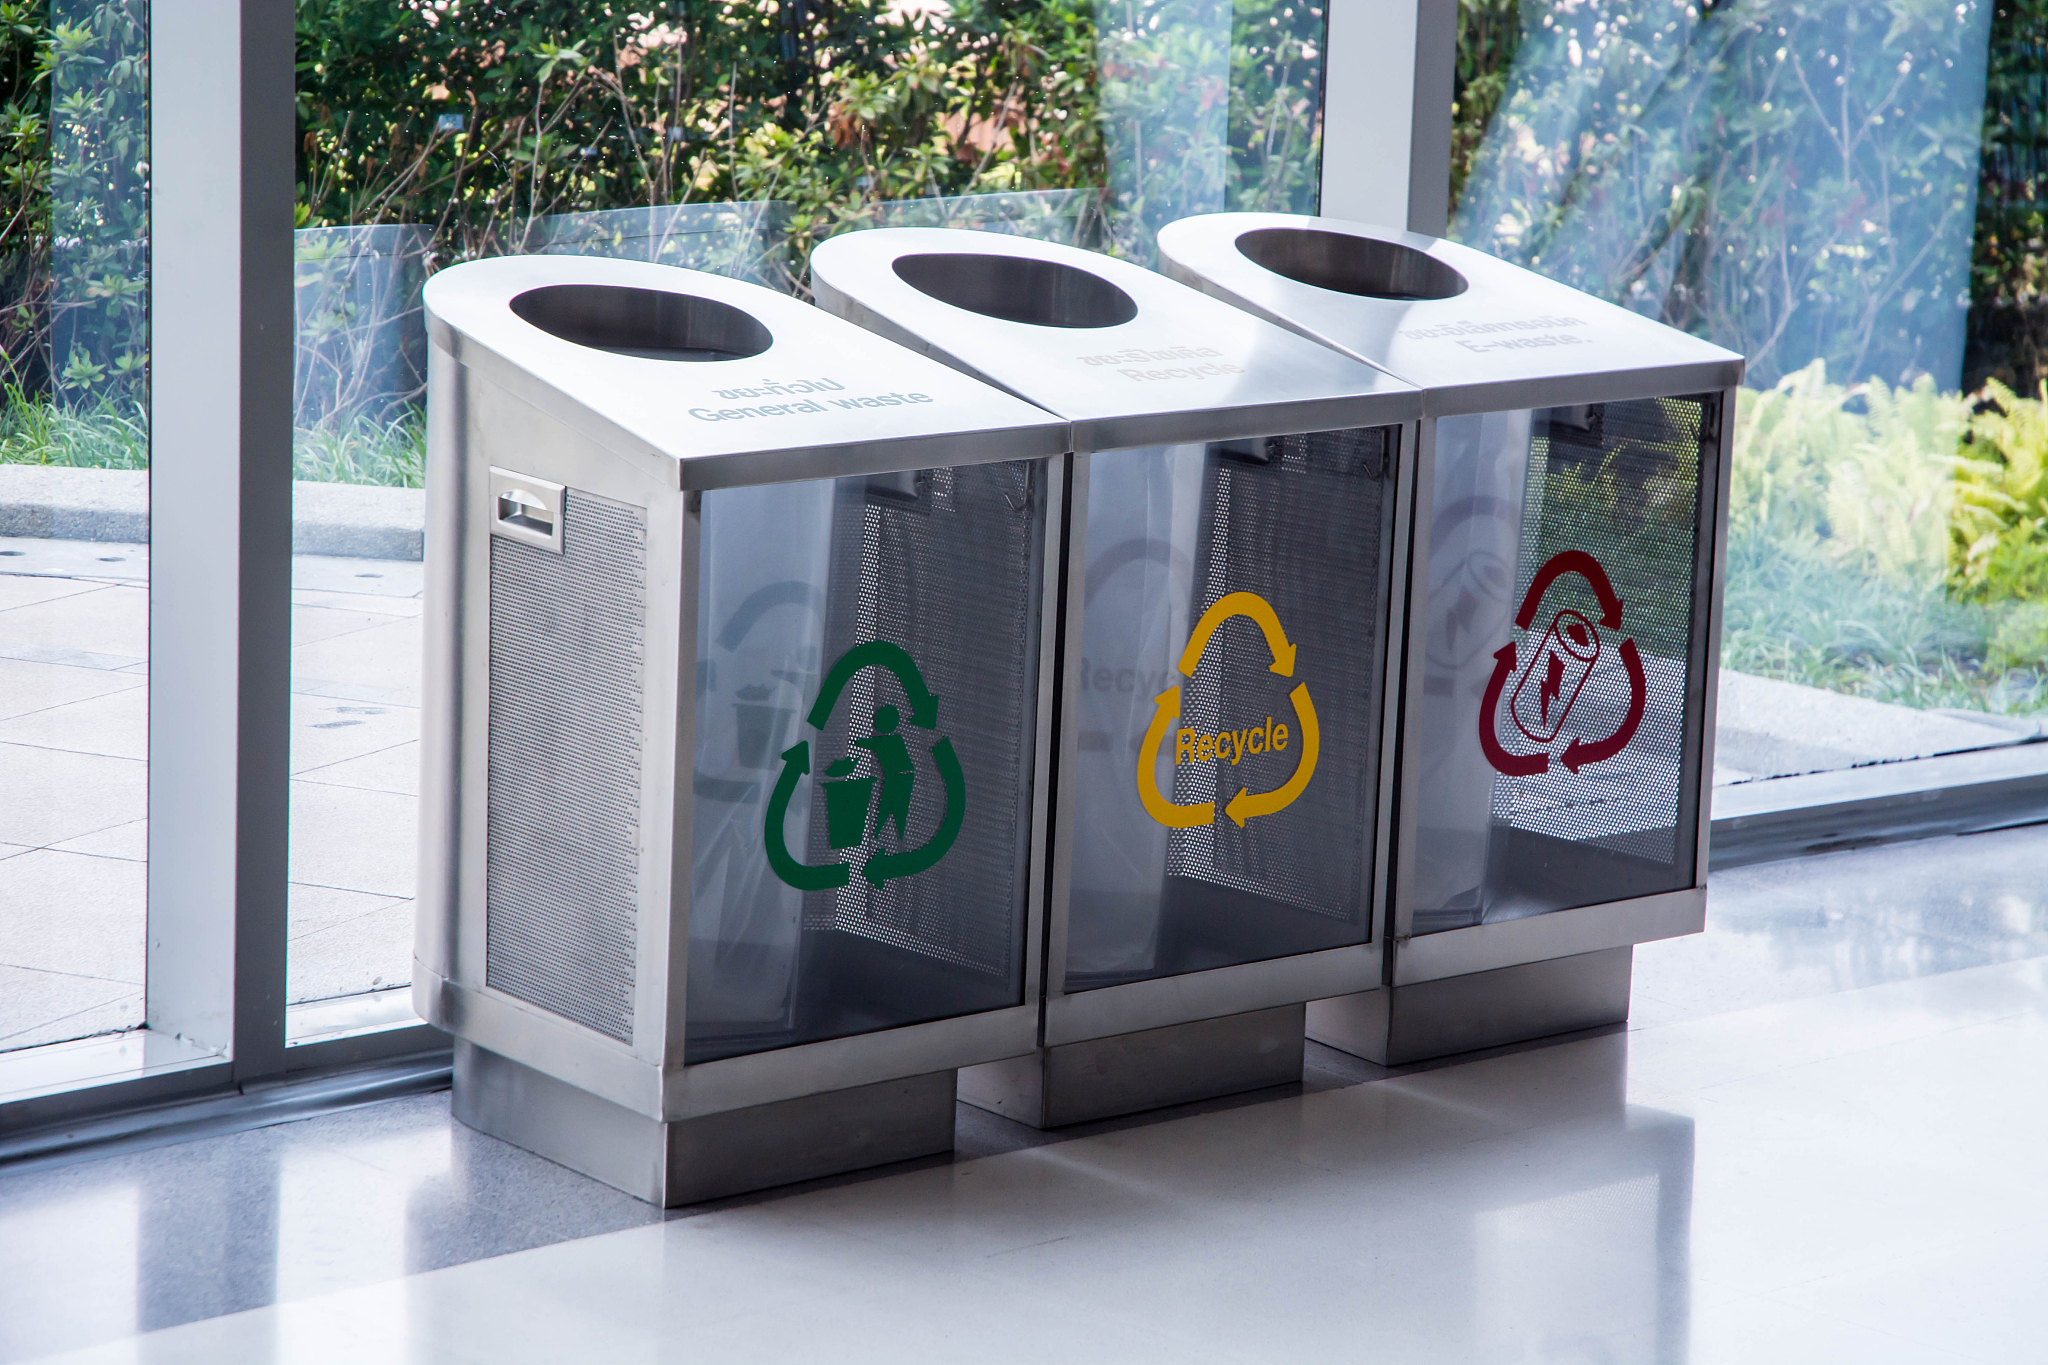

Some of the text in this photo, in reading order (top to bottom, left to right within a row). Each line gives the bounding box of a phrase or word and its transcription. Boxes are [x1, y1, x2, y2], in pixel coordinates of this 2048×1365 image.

[1116, 362, 1245, 382] Recycle
[711, 378, 846, 400] ขยะทั่วไป
[688, 391, 934, 422] General waste
[1175, 716, 1289, 765] Recycle
